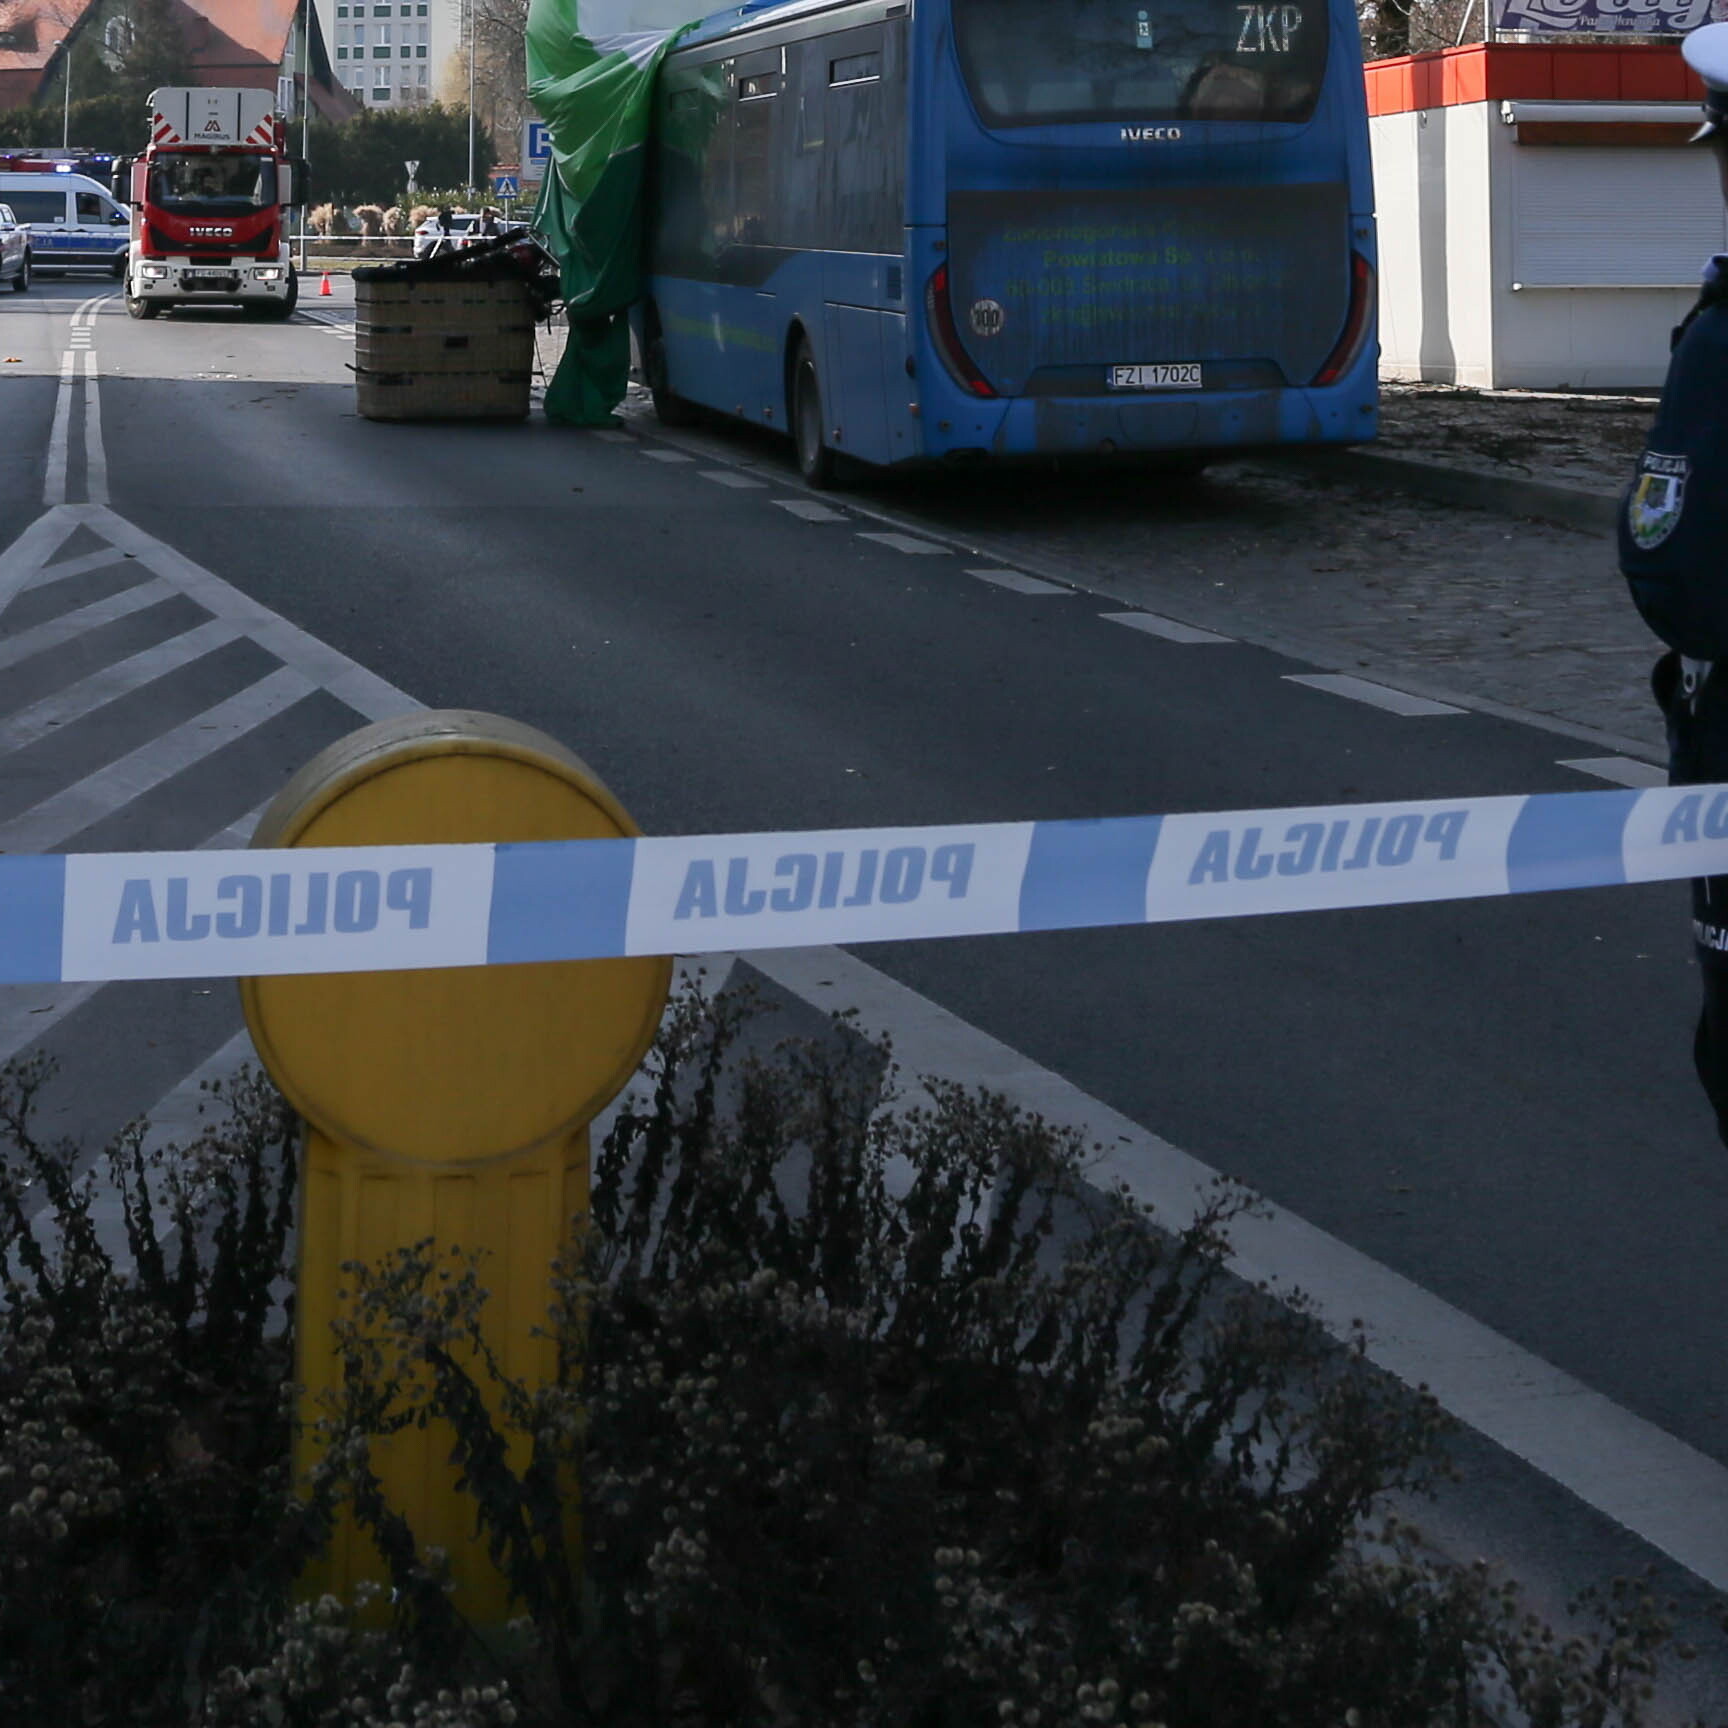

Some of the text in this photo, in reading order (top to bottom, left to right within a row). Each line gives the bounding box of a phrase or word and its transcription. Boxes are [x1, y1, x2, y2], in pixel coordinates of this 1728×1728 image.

[1235, 4, 1303, 53] ZKP
[1120, 126, 1182, 141] IVECO
[189, 227, 233, 238] IVECO
[1114, 365, 1201, 385] FZI 1702C
